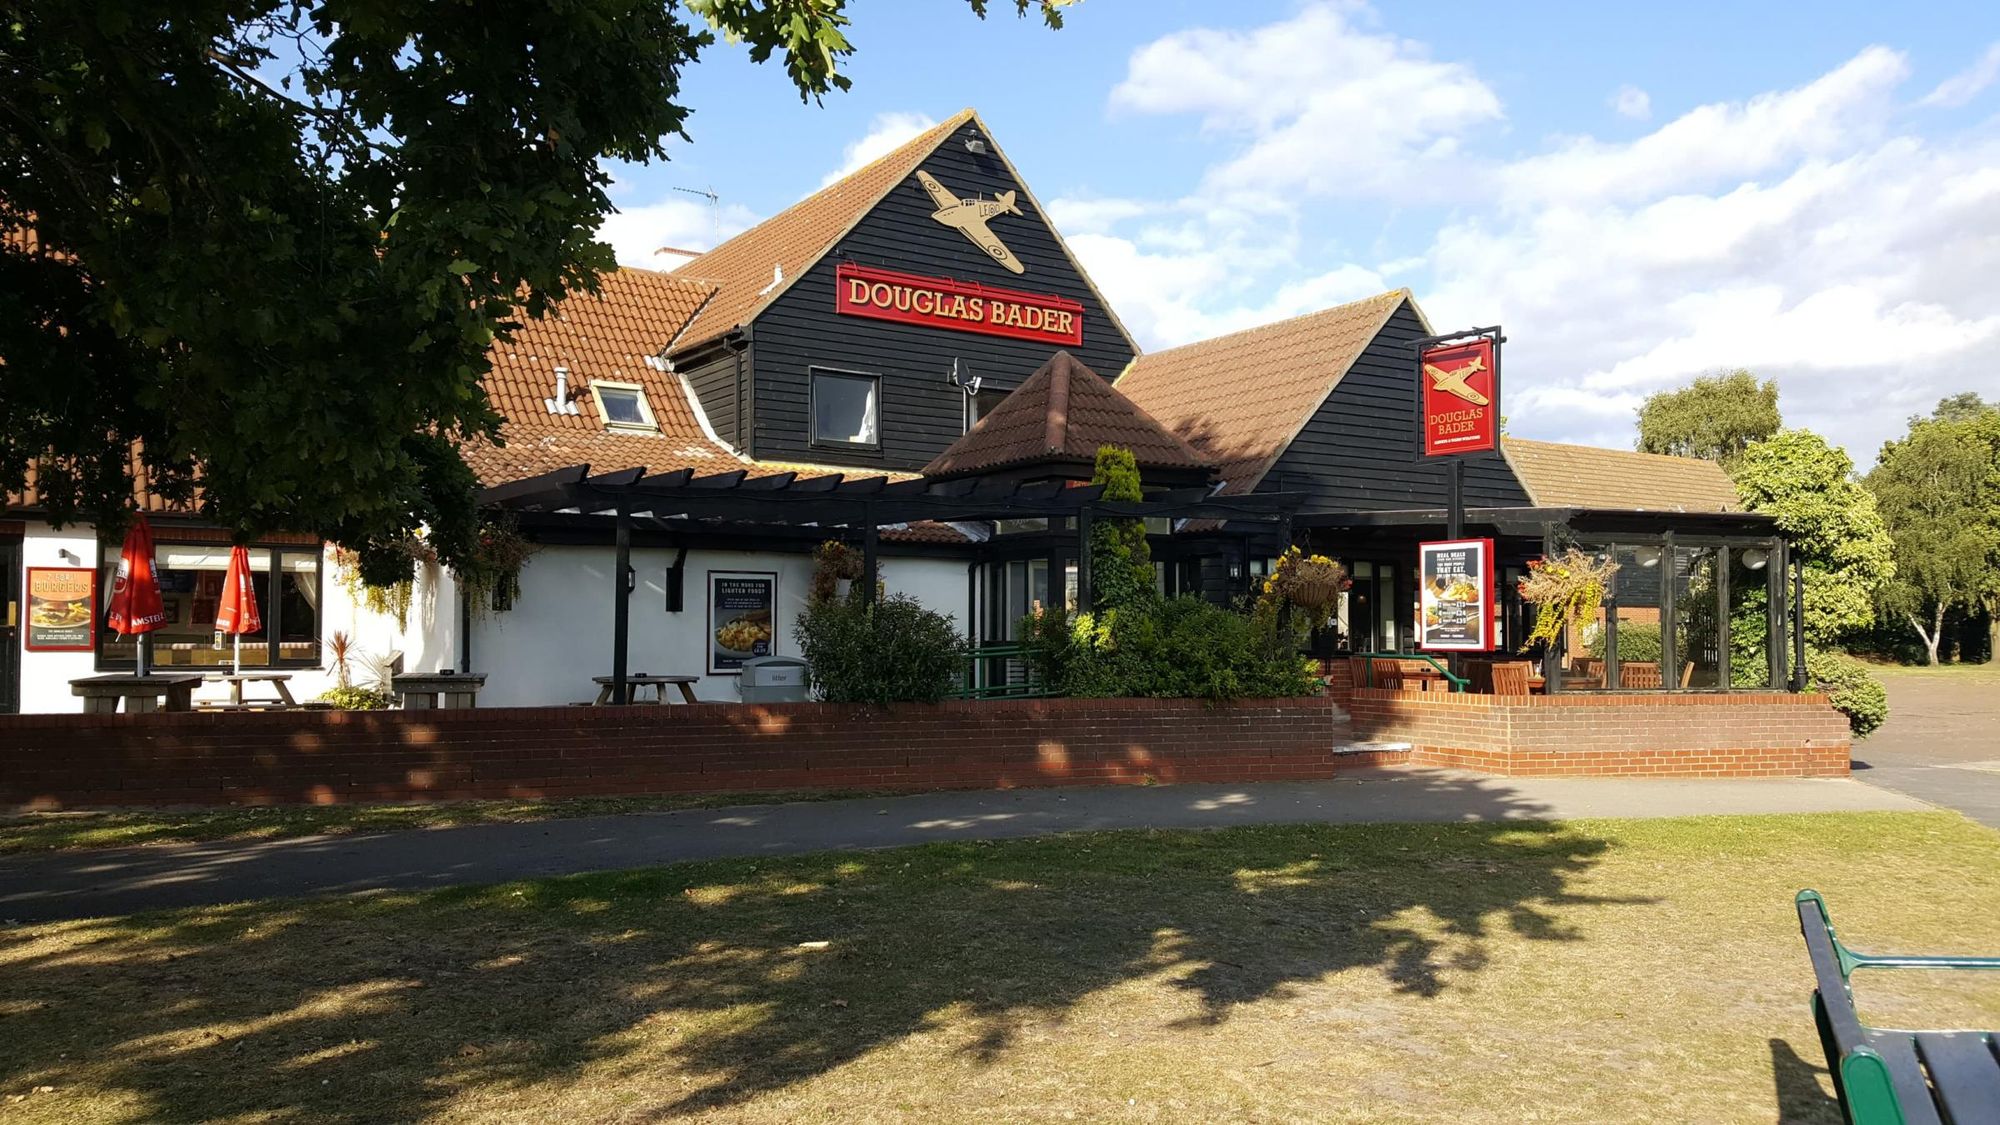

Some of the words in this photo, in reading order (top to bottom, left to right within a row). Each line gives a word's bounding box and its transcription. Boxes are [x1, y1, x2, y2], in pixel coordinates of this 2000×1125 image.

[849, 278, 984, 322] DOUGLAS
[990, 300, 1074, 334] BADER
[1430, 408, 1483, 425] DOUGLAS
[1438, 421, 1475, 436] BADER
[34, 580, 89, 593] BURGERS
[131, 614, 164, 626] AMSTEL
